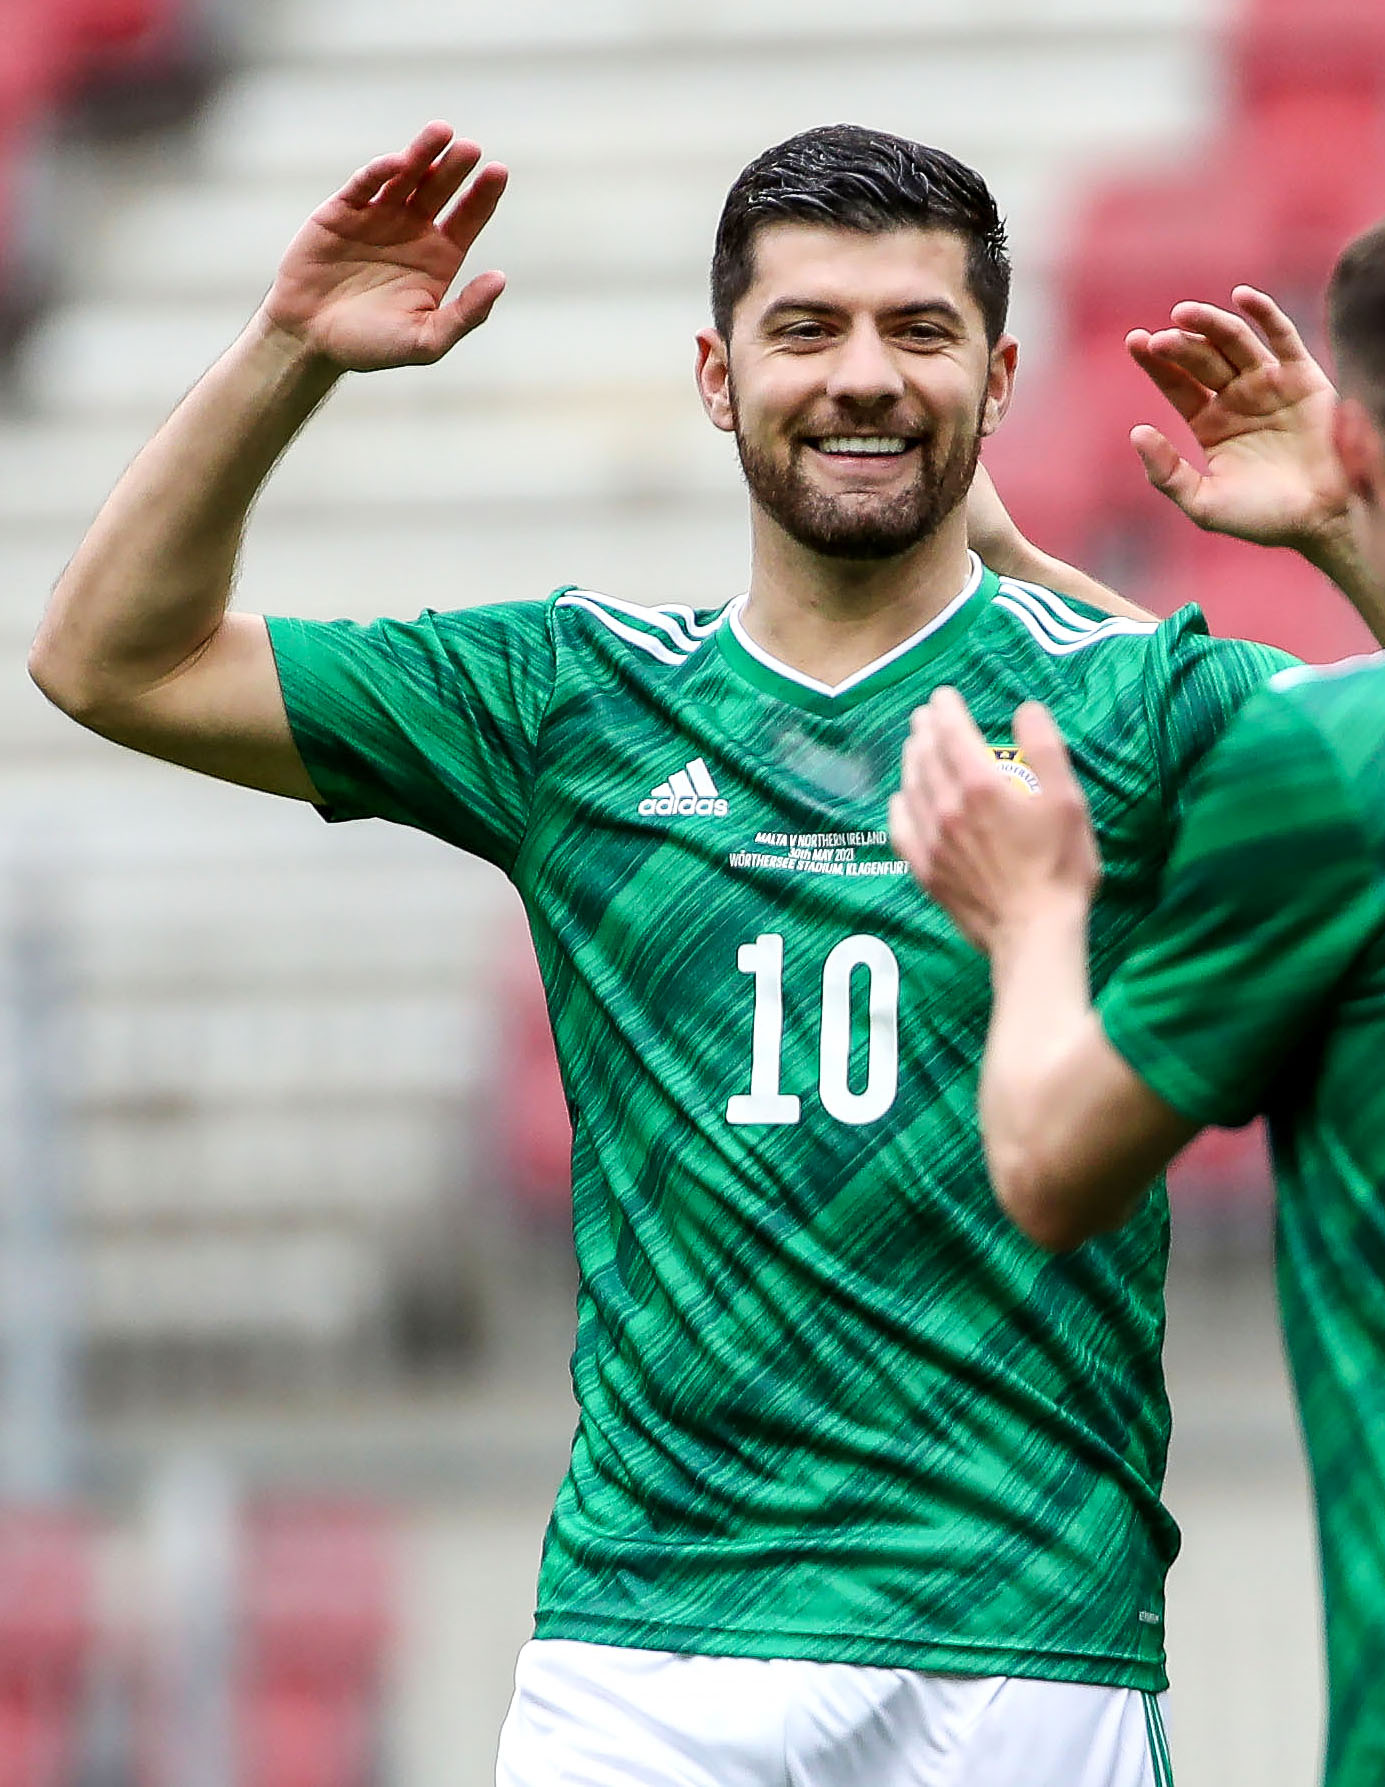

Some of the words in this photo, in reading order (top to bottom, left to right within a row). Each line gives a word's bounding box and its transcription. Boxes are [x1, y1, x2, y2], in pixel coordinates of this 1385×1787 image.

[638, 796, 729, 817] adidas
[754, 832, 788, 846] MALTA
[789, 834, 798, 847] V
[798, 833, 846, 848] NORTHERN
[846, 831, 887, 847] IRELAND
[811, 849, 835, 862] MAY
[834, 848, 855, 862] 2021
[845, 861, 910, 876] KLAGENFURT
[726, 933, 900, 1126] 10
